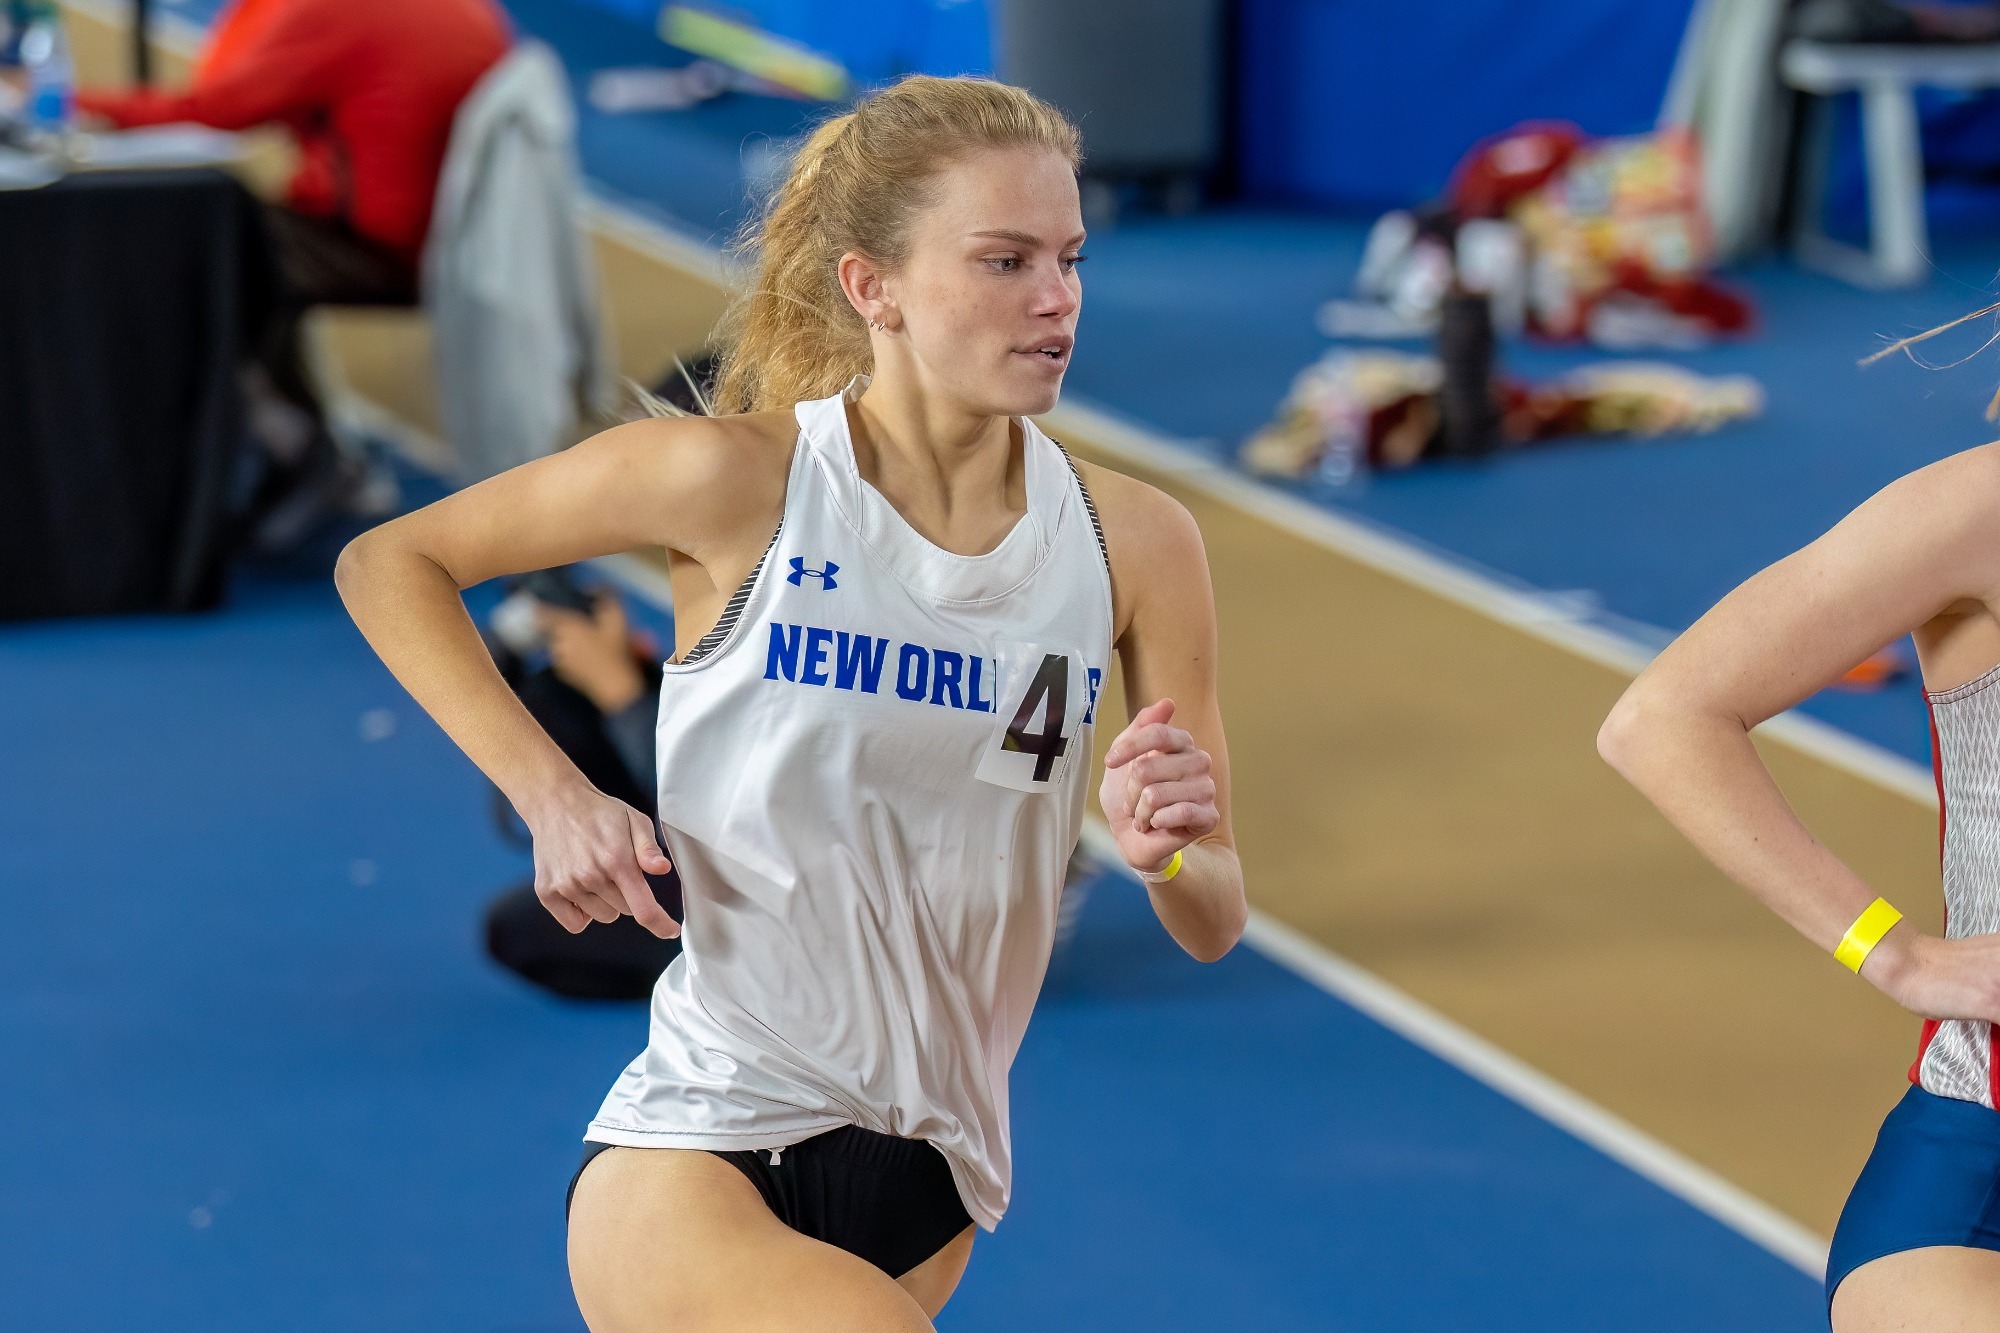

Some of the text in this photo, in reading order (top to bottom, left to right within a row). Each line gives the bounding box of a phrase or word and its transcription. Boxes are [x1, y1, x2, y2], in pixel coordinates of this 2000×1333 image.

[763, 622, 1101, 724] NEW ORLS
[1001, 653, 1069, 782] 4
